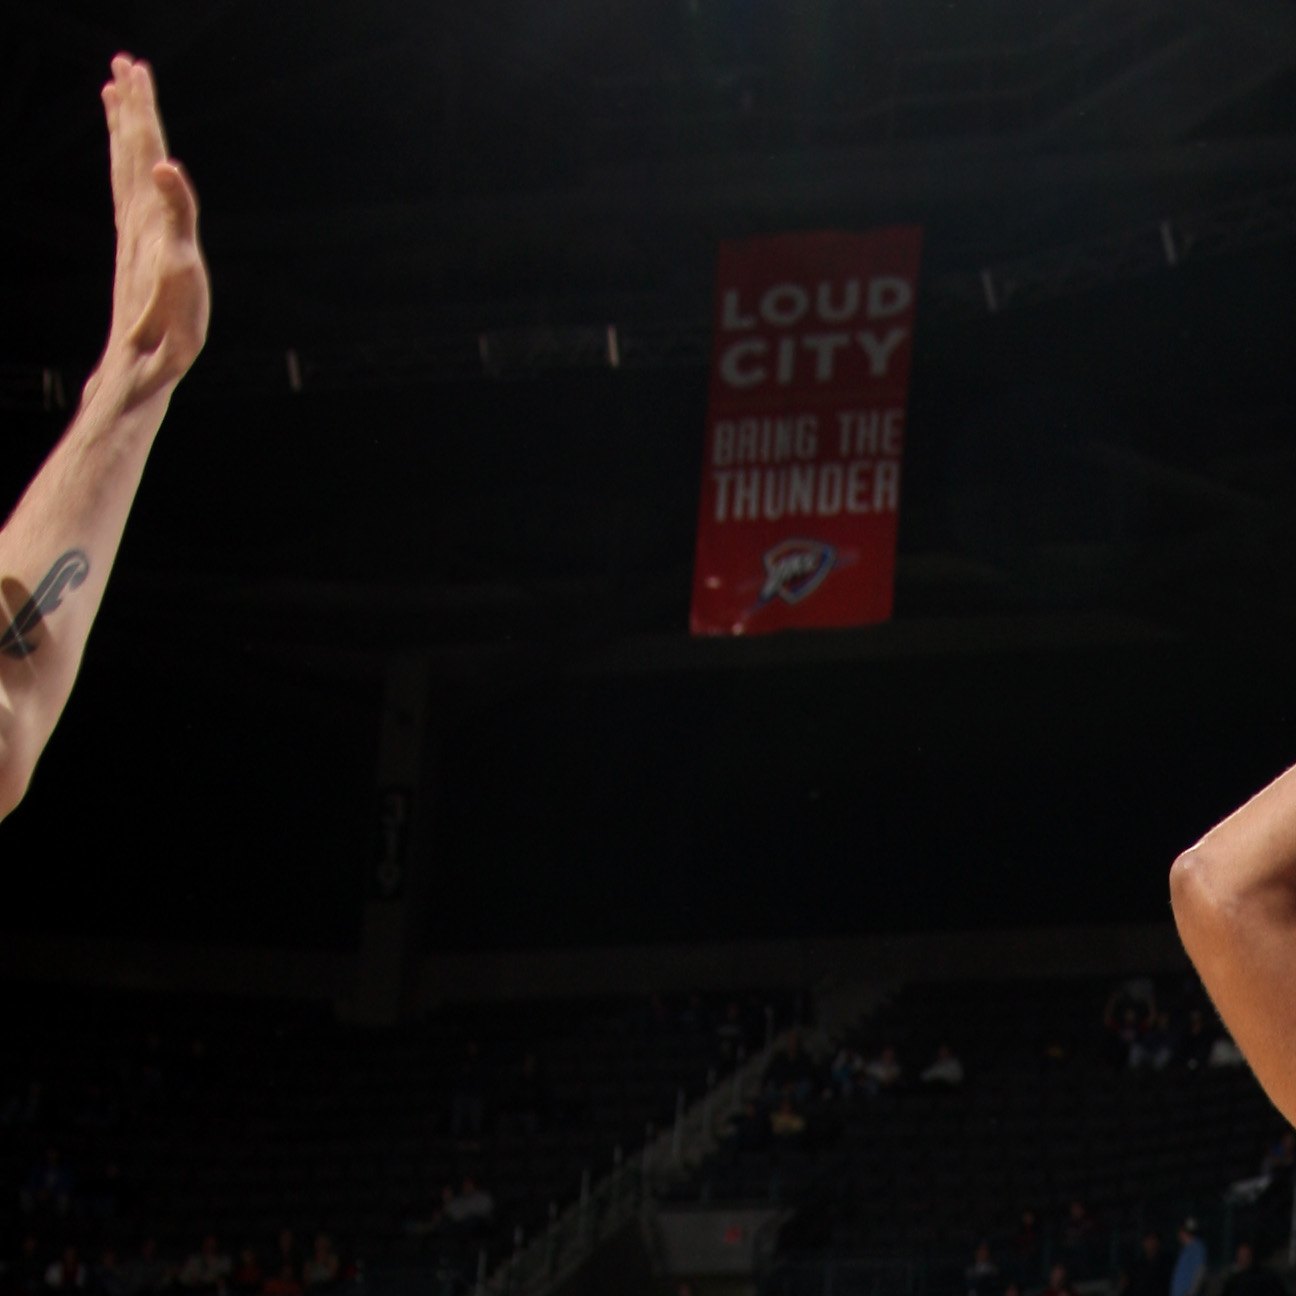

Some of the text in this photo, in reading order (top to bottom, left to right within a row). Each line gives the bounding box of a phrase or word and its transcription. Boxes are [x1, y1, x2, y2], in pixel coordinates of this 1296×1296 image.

[722, 276, 912, 331] LOUD
[719, 329, 907, 389] CITY
[713, 406, 903, 467] BRING THE
[713, 459, 900, 523] THUNDER
